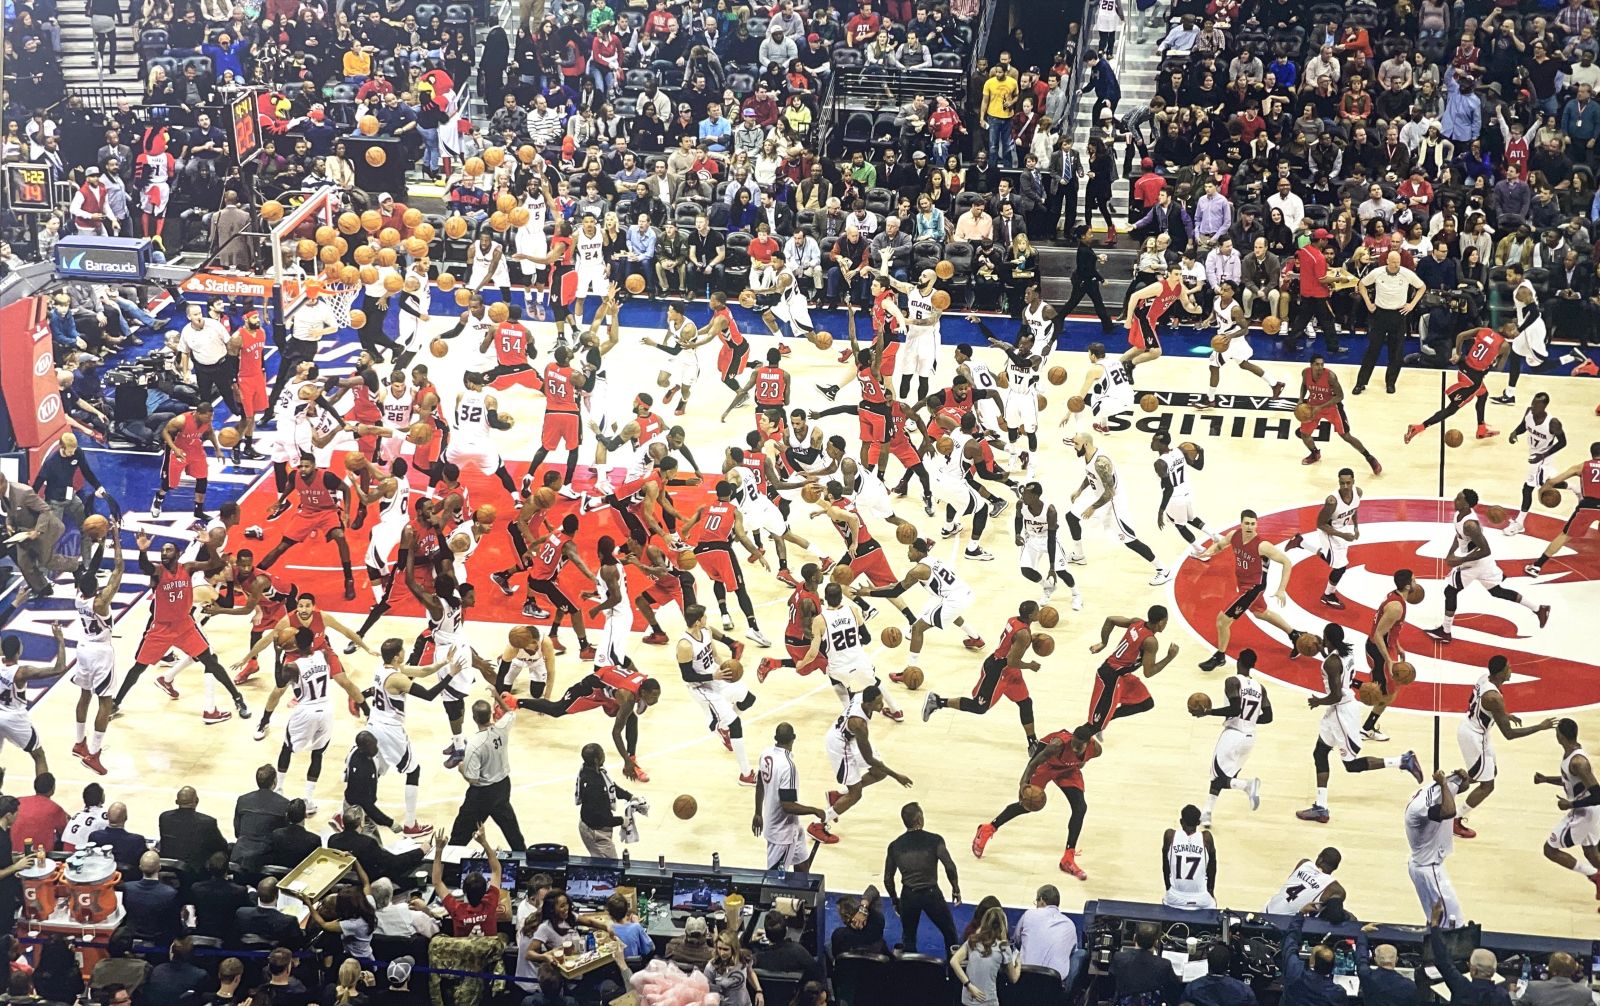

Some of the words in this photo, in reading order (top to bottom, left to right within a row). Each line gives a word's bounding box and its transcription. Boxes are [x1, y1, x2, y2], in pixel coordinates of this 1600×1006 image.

[1102, 1, 1114, 11] 26
[20, 170, 45, 184] 7:22
[535, 212, 540, 221] 5
[585, 251, 599, 261] 24
[84, 259, 137, 274] Barracuda
[911, 300, 933, 312] ATLANTA
[916, 311, 922, 320] 6
[502, 336, 522, 354] 54
[1473, 343, 1489, 361] 31
[254, 349, 259, 360] 3
[979, 372, 993, 387] 0
[1014, 374, 1024, 385] 17
[548, 379, 567, 398] 54
[760, 382, 779, 398] 23
[1311, 393, 1325, 401] 23
[385, 404, 410, 412] ATLANTA
[460, 404, 483, 423] 32
[388, 412, 405, 422] 26
[1171, 464, 1186, 488] 17
[308, 496, 319, 504] 15
[705, 514, 722, 531] 10
[540, 542, 556, 565] 23
[1236, 557, 1249, 571] 50
[169, 591, 184, 604] 54
[832, 626, 858, 652] 26
[1115, 638, 1130, 659] 10
[307, 674, 329, 701] 17
[1241, 697, 1260, 722] 17
[493, 736, 503, 750] 31
[1175, 855, 1202, 881] 17
[1296, 870, 1320, 891] MILLSAP
[25, 887, 37, 901] G
[78, 893, 91, 906] G
[1285, 883, 1307, 903] 4
